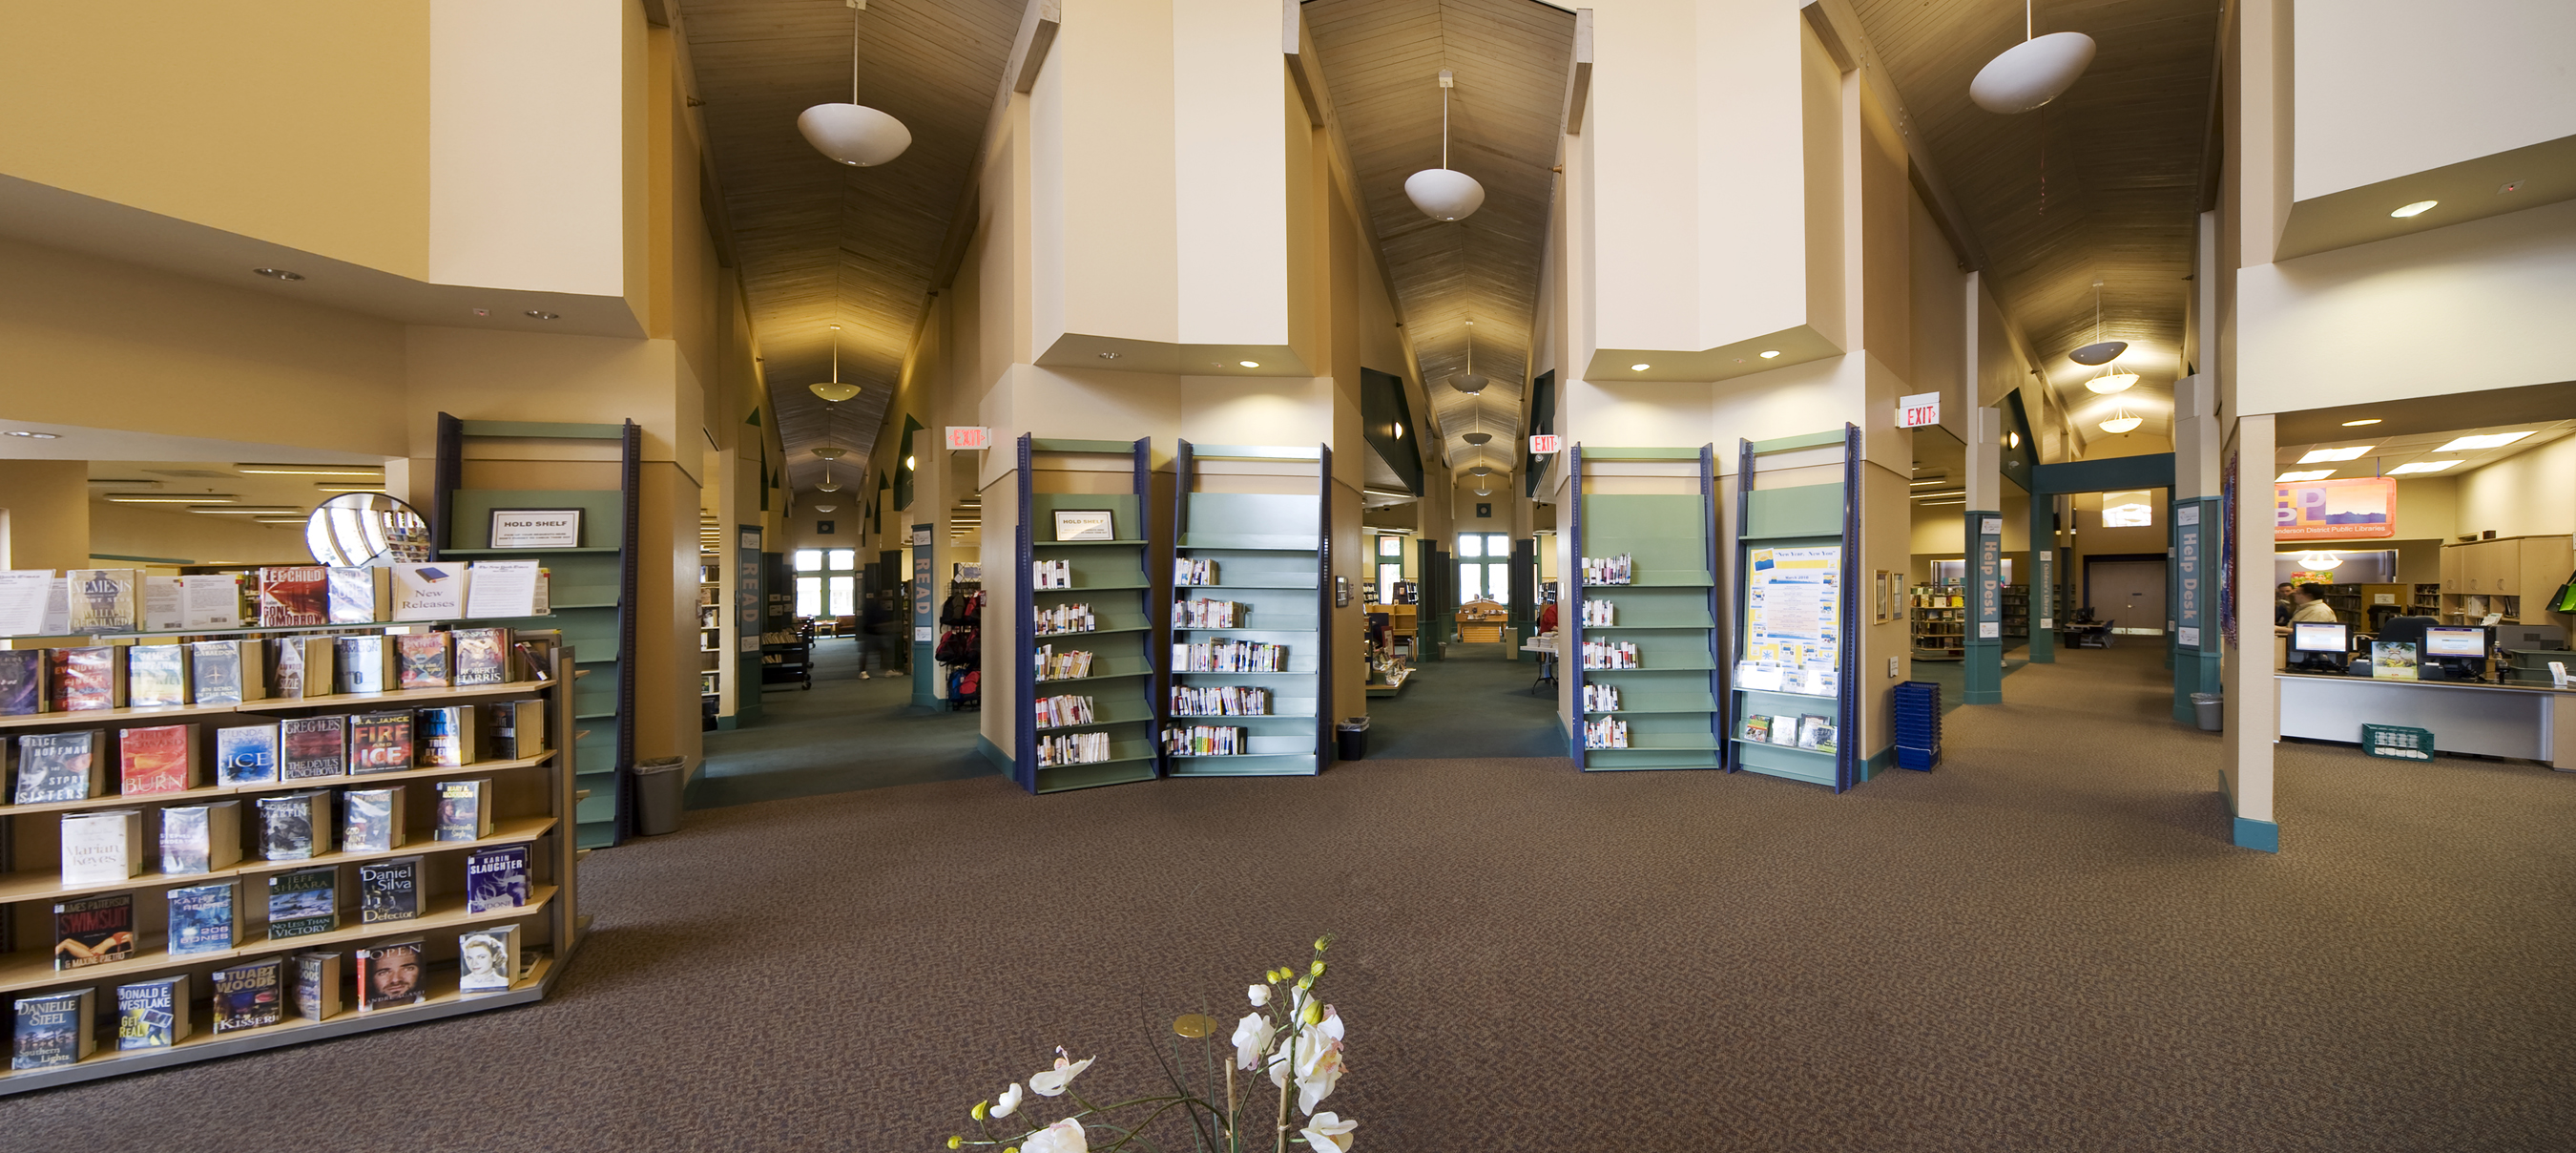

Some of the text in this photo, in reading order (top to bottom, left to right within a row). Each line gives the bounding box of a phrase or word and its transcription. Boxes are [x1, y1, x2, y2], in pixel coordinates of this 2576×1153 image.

[1908, 406, 1934, 426] EXIT
[954, 430, 982, 446] EXIT
[1535, 436, 1555, 451] EXIT
[1981, 541, 1997, 575] Help
[2180, 533, 2197, 573] Help
[263, 570, 322, 583] LEE CHILD
[73, 579, 133, 594] NEMESIS
[415, 589, 443, 597] New
[742, 562, 758, 621] READ
[916, 558, 931, 615] READ
[402, 600, 455, 609] Releases
[1984, 580, 1997, 616] Desk
[2183, 578, 2197, 619] Desk
[263, 605, 292, 616] GONE
[264, 614, 322, 626] TOMORROW
[460, 666, 497, 675] ROBERT
[456, 673, 501, 683] HARRIS
[365, 715, 376, 724] A.
[377, 715, 409, 725] JANCE
[231, 728, 264, 738] LINDA
[286, 720, 341, 734] GREG ILES
[354, 723, 410, 744] FIRE
[34, 745, 89, 757] HOFFMAN
[361, 746, 403, 765] ICE
[228, 752, 269, 768] ICE
[288, 758, 340, 770] THE DEVIL'S
[286, 766, 342, 779] PUNCHBOWL
[49, 775, 85, 786] STORY
[125, 773, 184, 793] BURN
[19, 788, 85, 804] SISTERS
[260, 808, 307, 819] MARTIN
[67, 844, 120, 856] Marian
[73, 854, 116, 867] Keyes
[484, 854, 509, 865] KARIN
[470, 859, 523, 875] SLAUGHTER
[287, 873, 315, 885] JEFF
[363, 866, 411, 882] Daniel
[274, 880, 328, 892] SHAARA
[377, 879, 412, 891] Silva
[62, 895, 130, 913] AMES PATTERSON
[174, 893, 216, 906] KATHY
[472, 899, 513, 912] UNDONE
[60, 907, 129, 935] SWIMSUIT
[364, 908, 413, 923] Defector
[200, 925, 229, 934] 206
[275, 923, 327, 937] VICTORY
[179, 933, 229, 944] BONES
[370, 943, 423, 961] OPEN
[65, 959, 72, 970] &
[216, 975, 277, 994] WOODS
[119, 986, 171, 1000] DONALD E.
[18, 999, 76, 1016] DANIELLE
[119, 997, 171, 1011] WESTLAKE
[30, 1012, 67, 1026] STEEL
[121, 1016, 139, 1027] GET
[219, 1015, 276, 1031] KISSER
[119, 1026, 143, 1038] REAL
[18, 1046, 61, 1058] Southern
[41, 1054, 70, 1063] Lights
